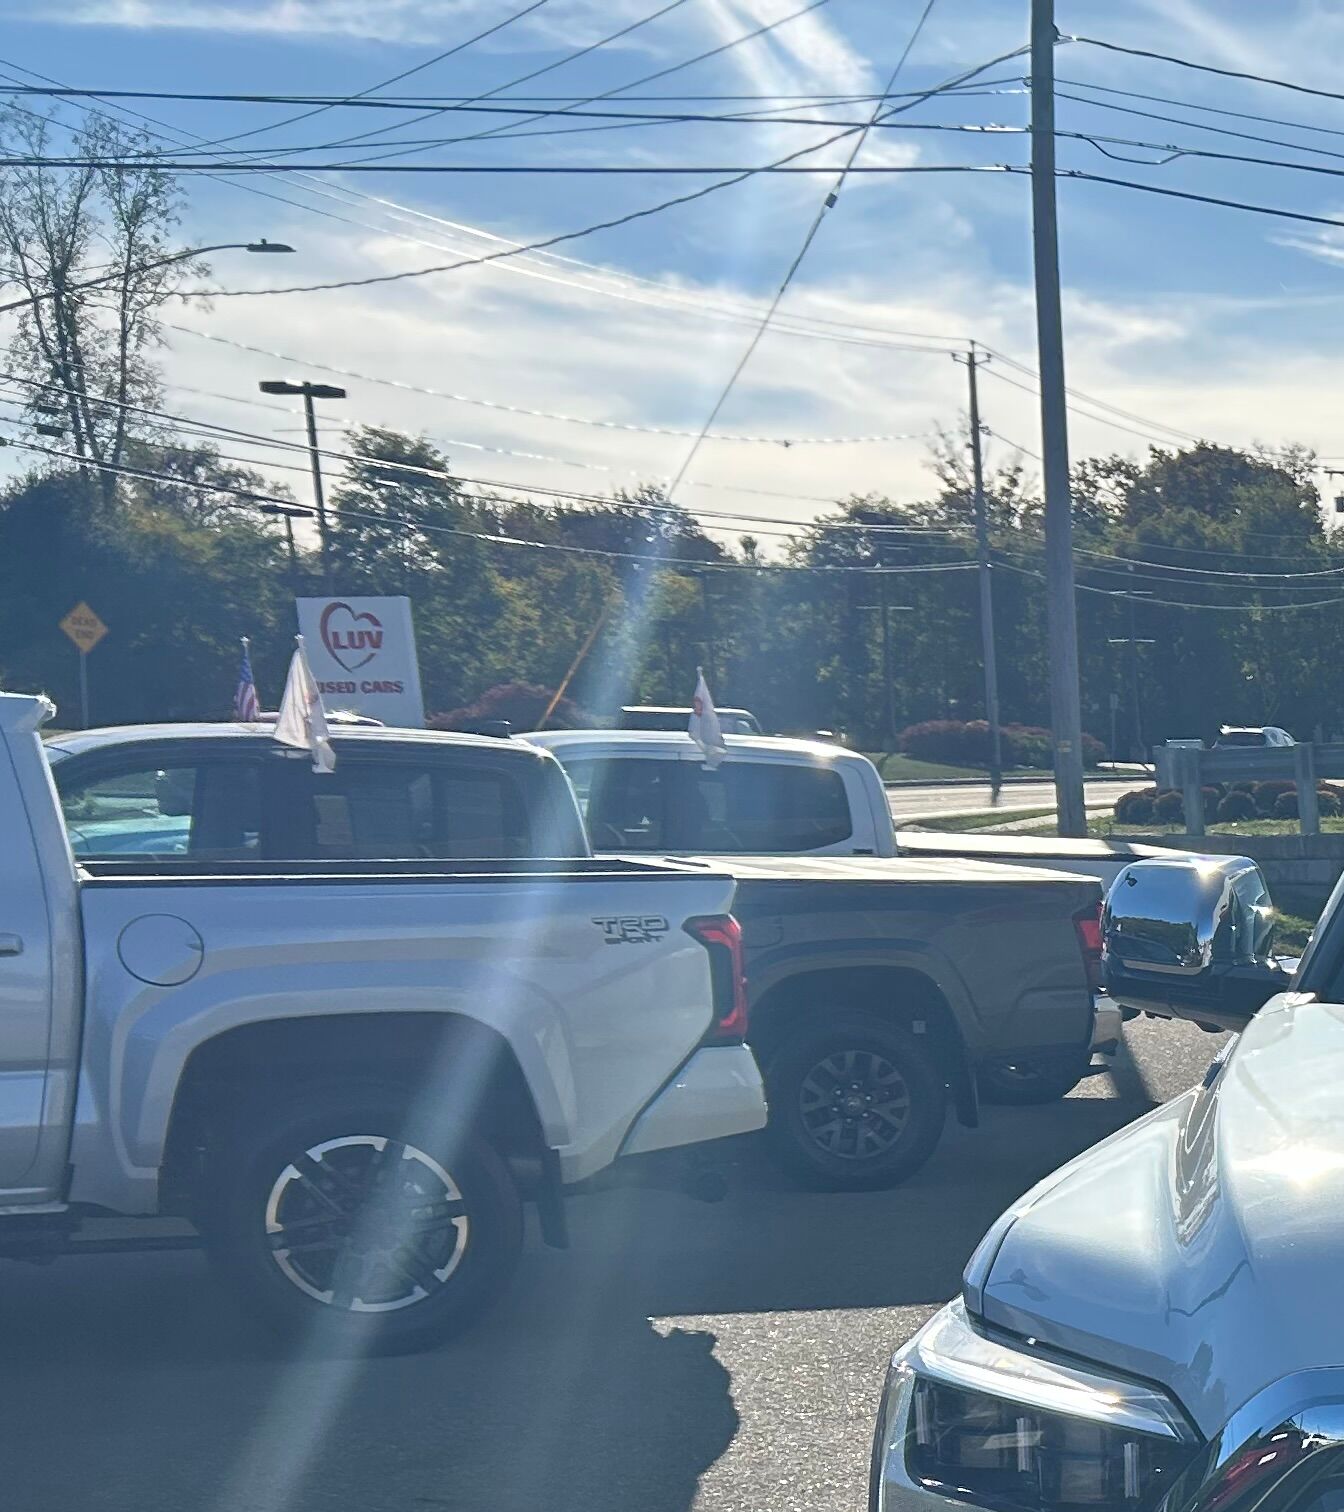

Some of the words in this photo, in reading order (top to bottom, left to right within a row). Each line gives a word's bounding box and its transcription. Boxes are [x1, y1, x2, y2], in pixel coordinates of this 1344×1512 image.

[332, 630, 384, 650] LUV
[360, 680, 404, 694] CARS
[591, 914, 669, 938] TRD
